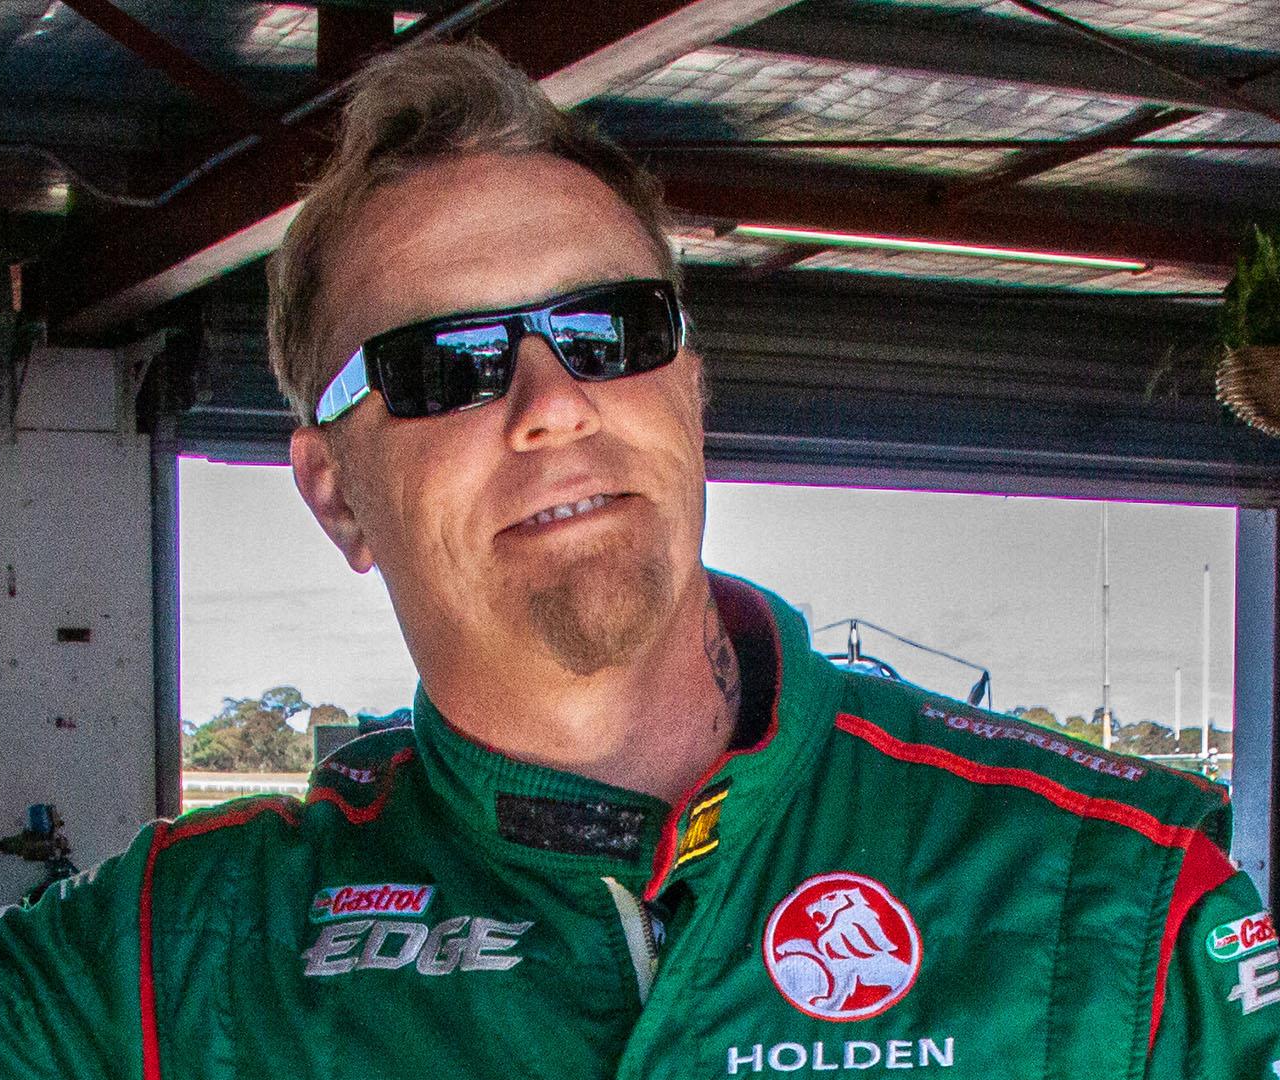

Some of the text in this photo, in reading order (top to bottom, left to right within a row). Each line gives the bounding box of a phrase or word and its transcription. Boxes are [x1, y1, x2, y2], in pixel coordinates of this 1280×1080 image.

[332, 885, 430, 914] Castrol
[302, 916, 535, 977] EDGE
[727, 1036, 956, 1075] HOLDEN
